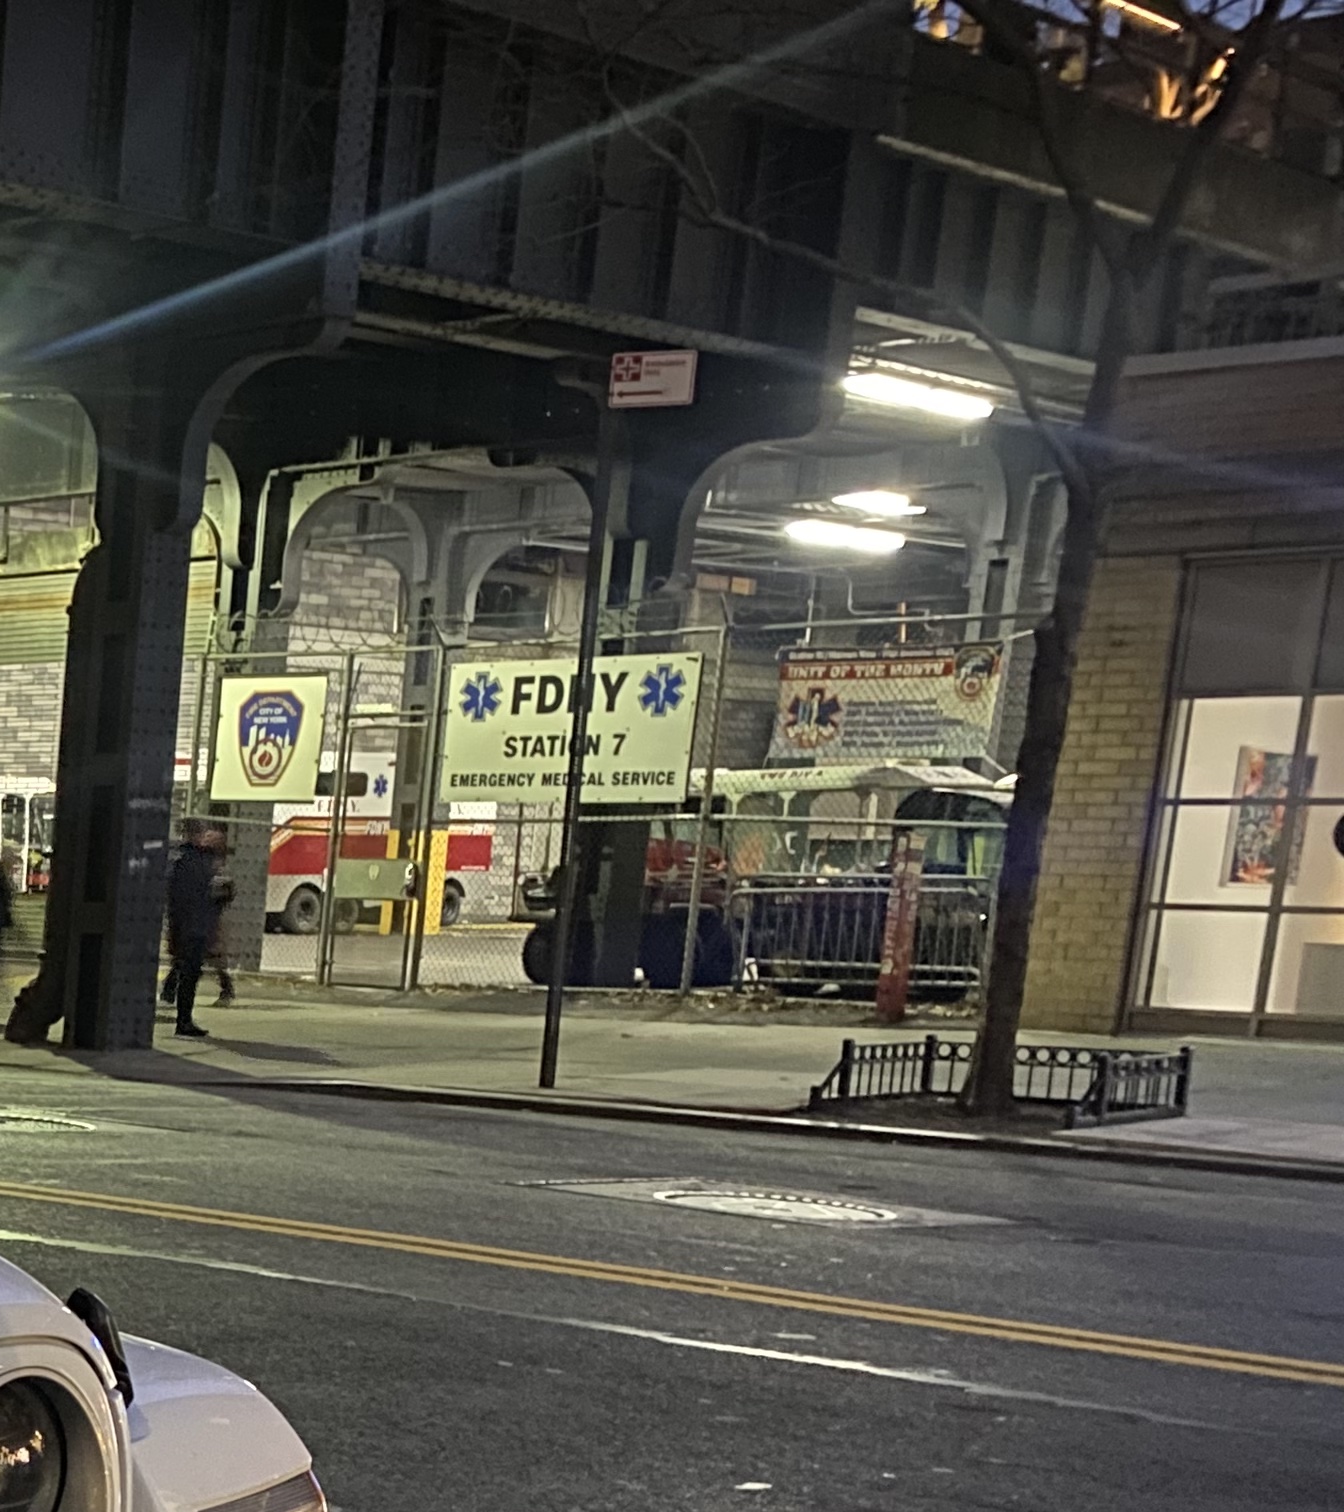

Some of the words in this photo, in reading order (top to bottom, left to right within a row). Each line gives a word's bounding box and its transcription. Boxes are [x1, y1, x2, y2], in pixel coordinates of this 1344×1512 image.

[503, 734, 602, 758] STATIN
[613, 734, 626, 756] 7
[450, 773, 535, 787] EMERGENCY
[541, 772, 605, 787] MEDCAL
[612, 772, 676, 786] SERVICE
